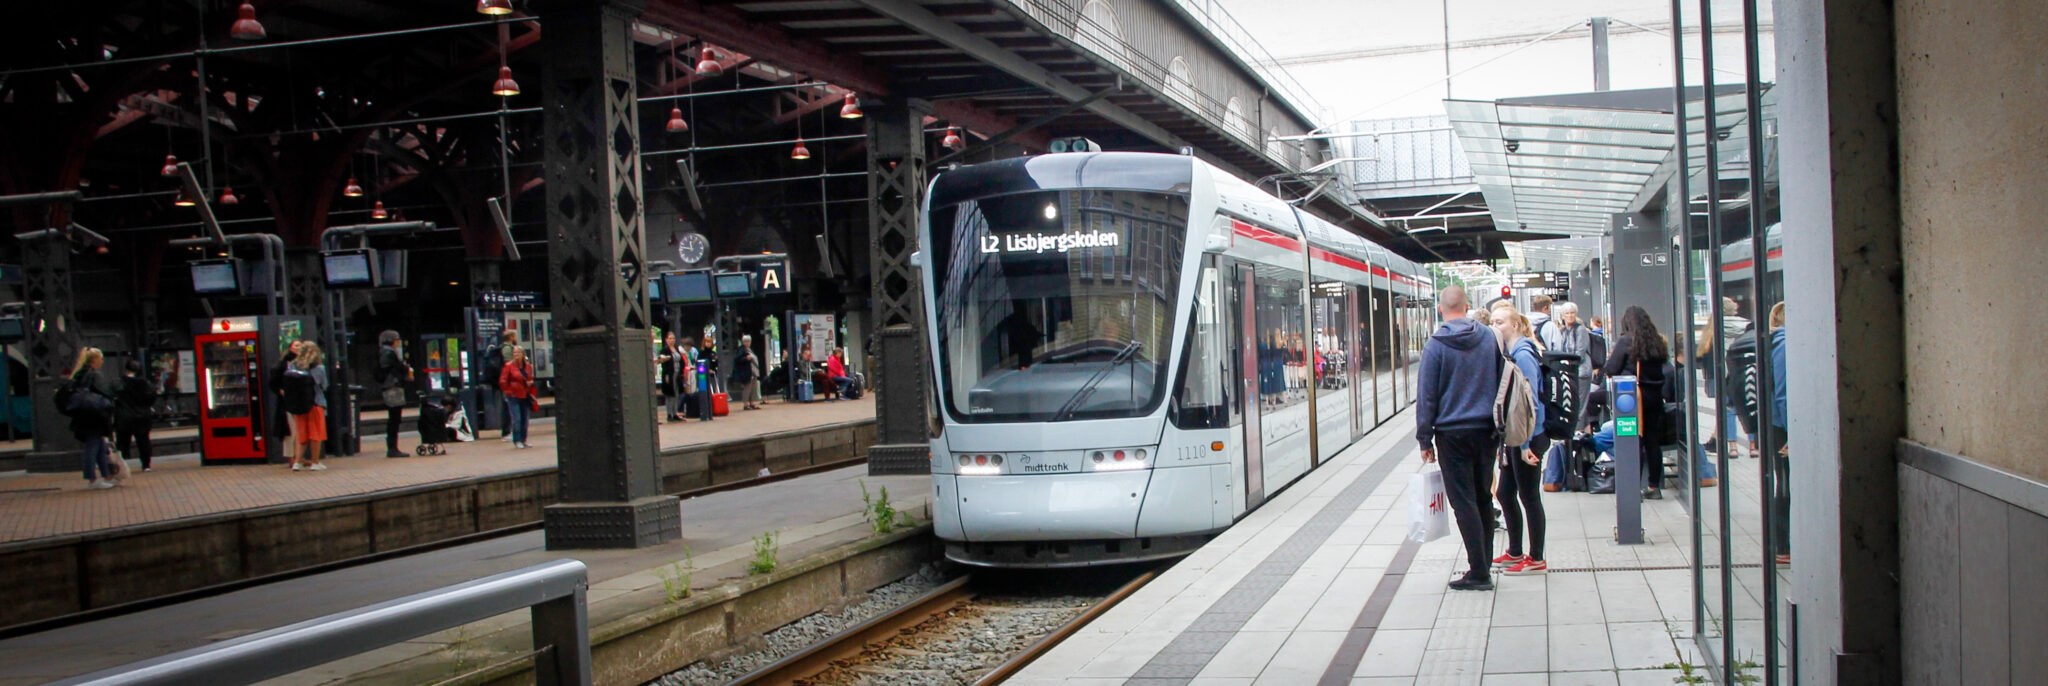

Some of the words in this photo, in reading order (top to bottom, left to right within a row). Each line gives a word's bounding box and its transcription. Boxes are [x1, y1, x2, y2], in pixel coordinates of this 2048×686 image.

[1627, 216, 1634, 226] 1
[981, 235, 999, 253] L2
[1006, 229, 1119, 254] Lisbjergskolen
[763, 269, 780, 289] A
[1177, 444, 1206, 460] 1110
[1024, 462, 1069, 472] midttrafik
